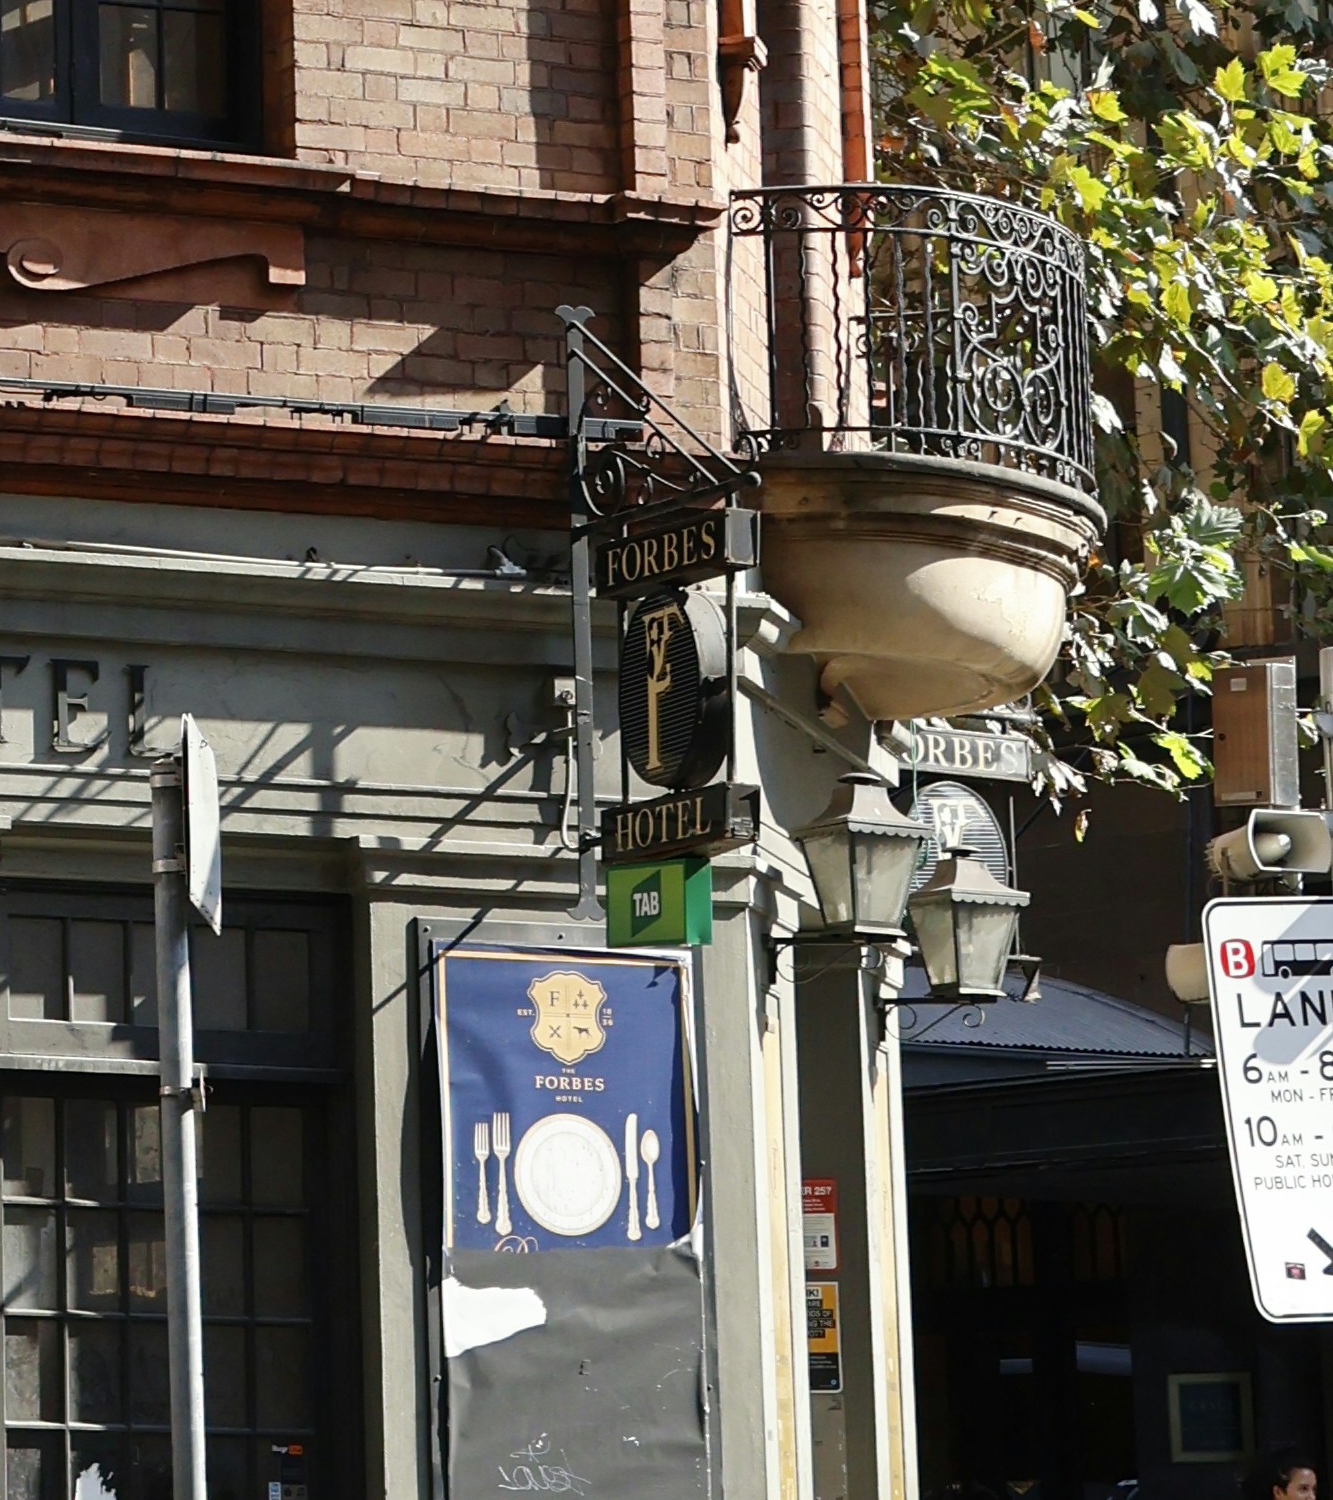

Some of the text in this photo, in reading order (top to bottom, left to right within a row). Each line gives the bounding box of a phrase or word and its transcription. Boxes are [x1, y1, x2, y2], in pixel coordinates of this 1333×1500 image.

[607, 520, 716, 587] FORBES
[616, 797, 712, 851] HOTEL
[633, 891, 660, 917] TAB
[549, 990, 560, 1007] F
[1237, 991, 1333, 1028] LAN
[535, 1075, 605, 1091] FORBES
[555, 1095, 583, 1103] HOTEL
[1271, 1089, 1303, 1103] MON
[1254, 1174, 1333, 1191] PUBLIC HO
